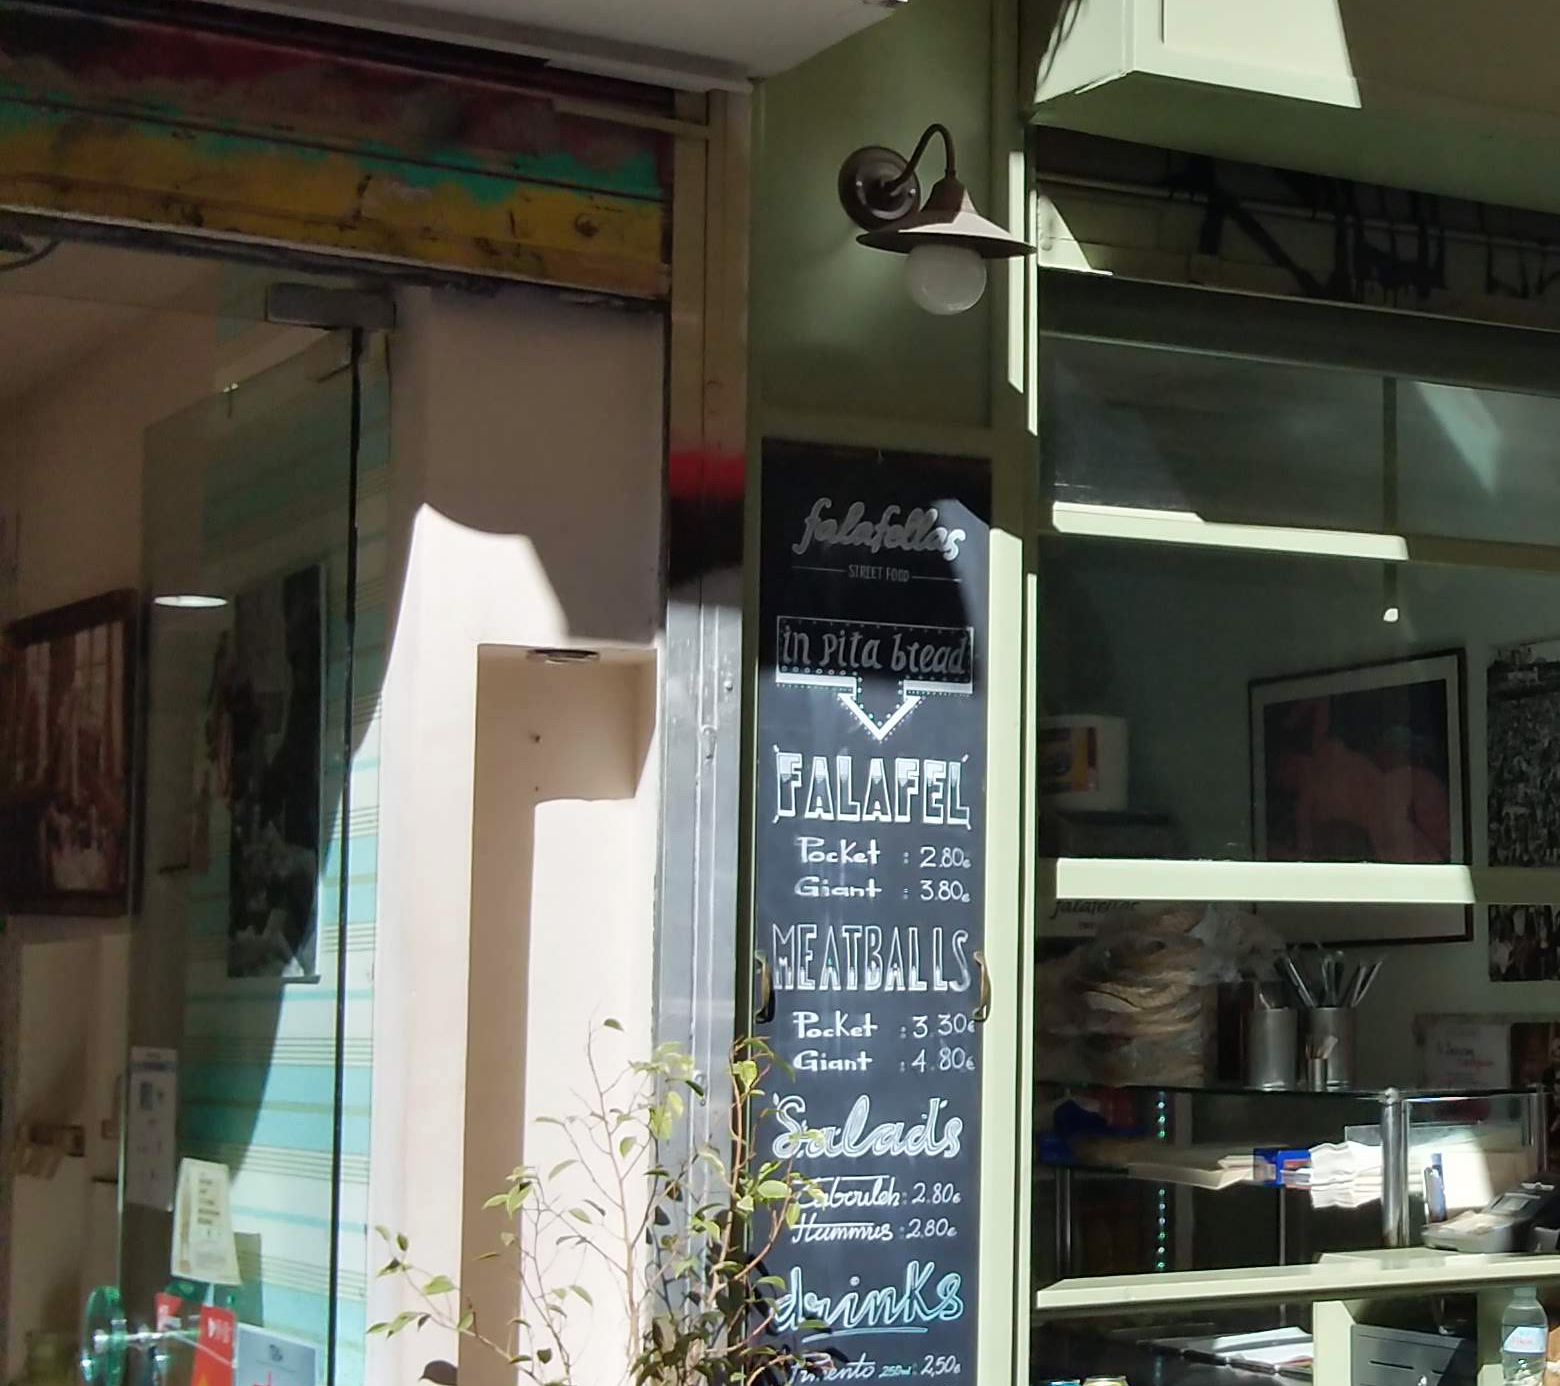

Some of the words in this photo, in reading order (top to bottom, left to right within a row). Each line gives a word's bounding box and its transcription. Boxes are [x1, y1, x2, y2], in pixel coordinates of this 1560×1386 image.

[792, 497, 966, 561] falafellas
[848, 564, 883, 581] STREET
[886, 566, 910, 582] FOOD
[782, 624, 811, 666] in
[892, 632, 969, 676] bread
[776, 752, 970, 825] FALAFEL
[794, 876, 882, 897] Giant
[772, 923, 971, 992] MEATBALLS
[793, 1051, 873, 1072] Giant
[773, 1093, 963, 1158] Salads
[792, 1213, 893, 1244] Hummus
